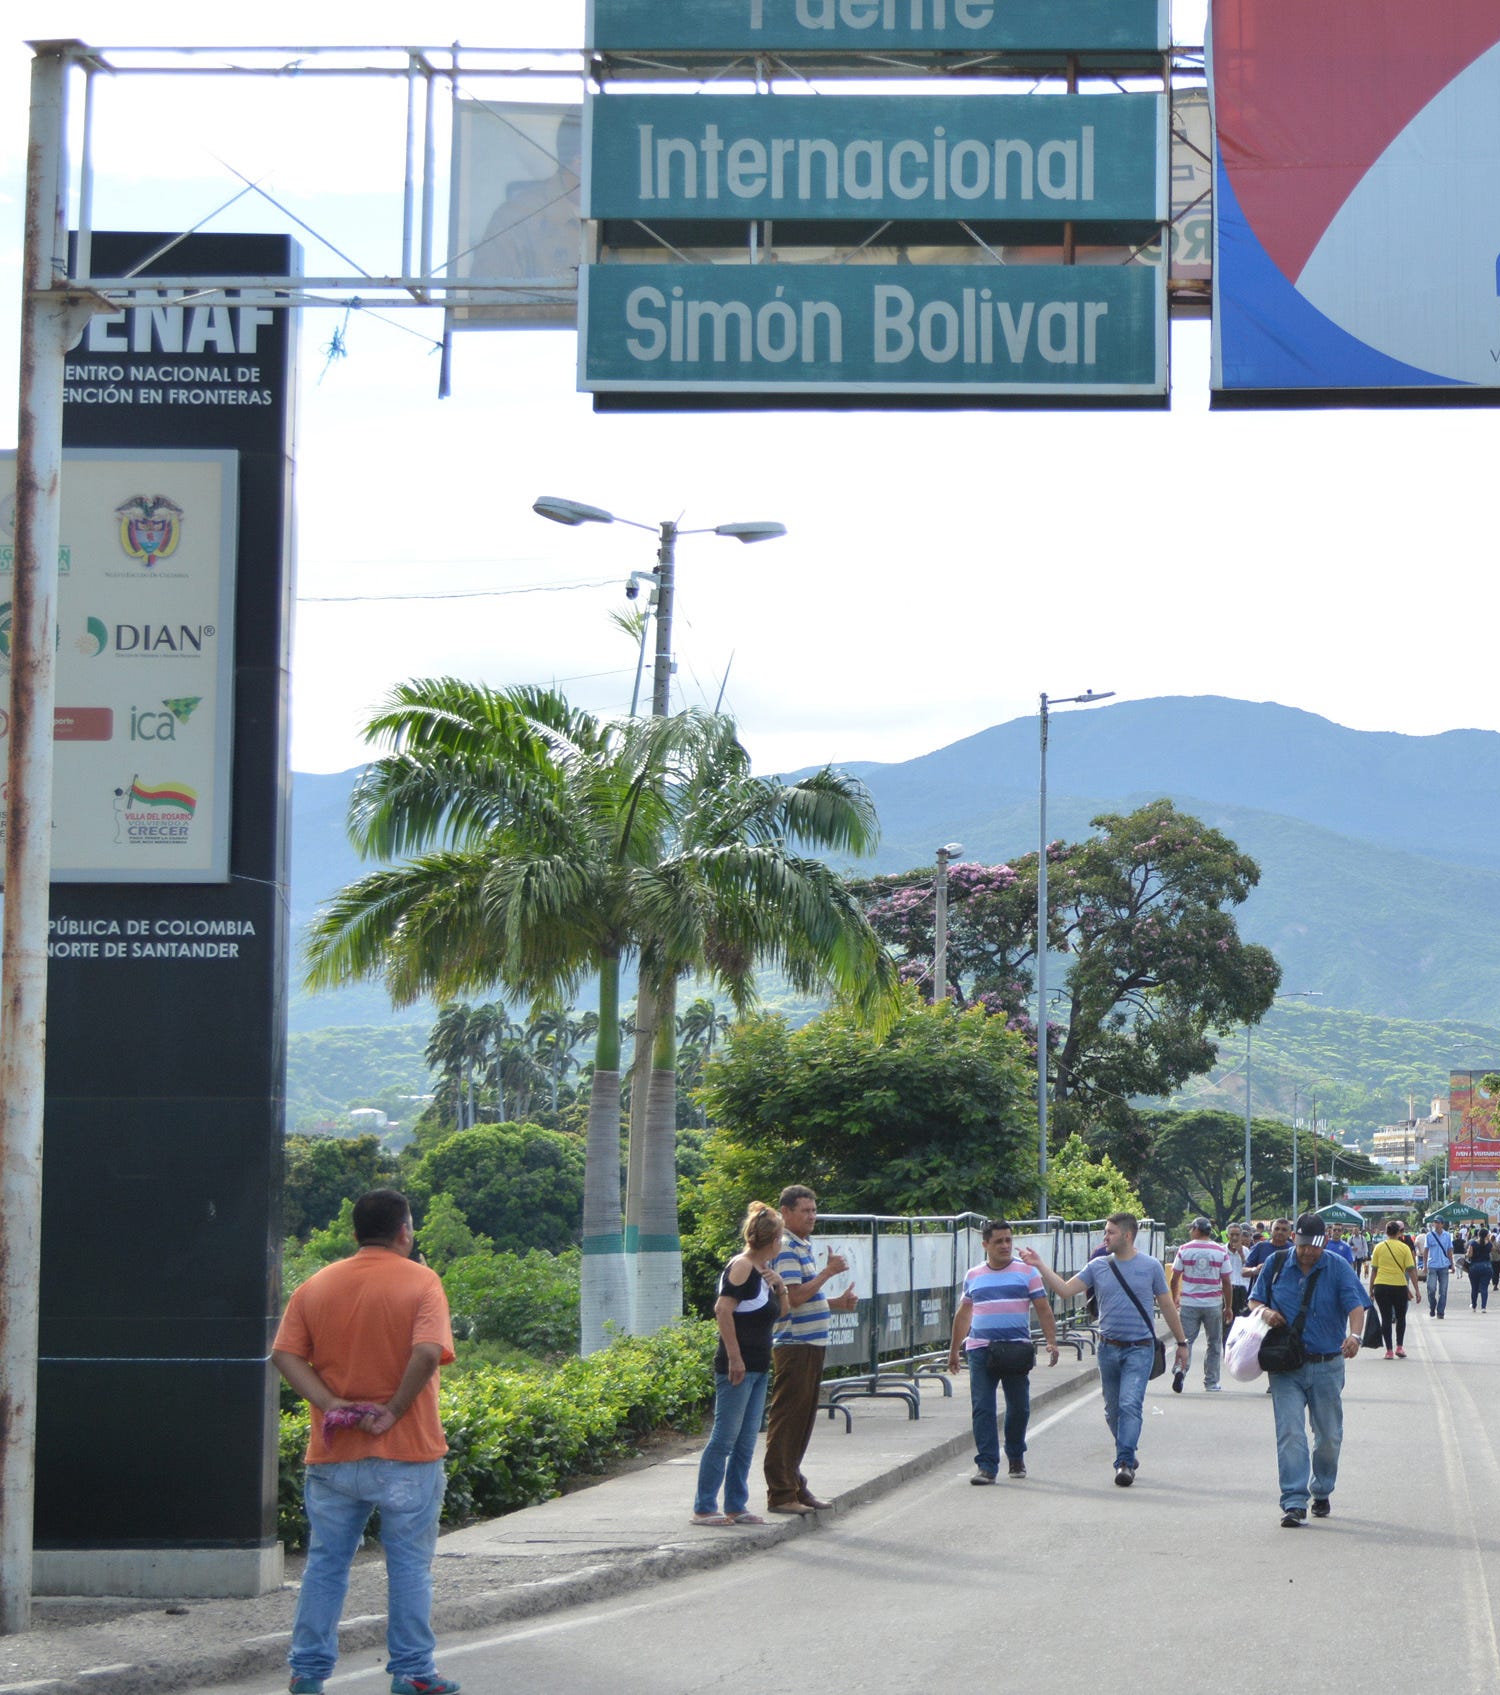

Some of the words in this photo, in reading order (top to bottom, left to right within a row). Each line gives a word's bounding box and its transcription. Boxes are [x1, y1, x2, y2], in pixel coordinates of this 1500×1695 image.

[637, 124, 1095, 201] Internacional
[88, 288, 274, 354] ENAF
[626, 285, 843, 364] Simón
[874, 285, 1108, 365] Bolivar
[65, 365, 124, 382] ENTRO
[130, 365, 232, 383] NACIONAL
[238, 367, 260, 383] DE
[63, 384, 133, 404] ENCIÓN
[140, 389, 163, 404] EN
[169, 389, 272, 406] FRONTERAS
[130, 705, 176, 741] ica
[128, 826, 189, 836] CRECER
[47, 915, 121, 936] PÚBLICA
[127, 920, 150, 935] DE
[154, 920, 256, 936] COLOMBIA
[104, 943, 127, 958] DE
[132, 942, 239, 959] SANTANDER
